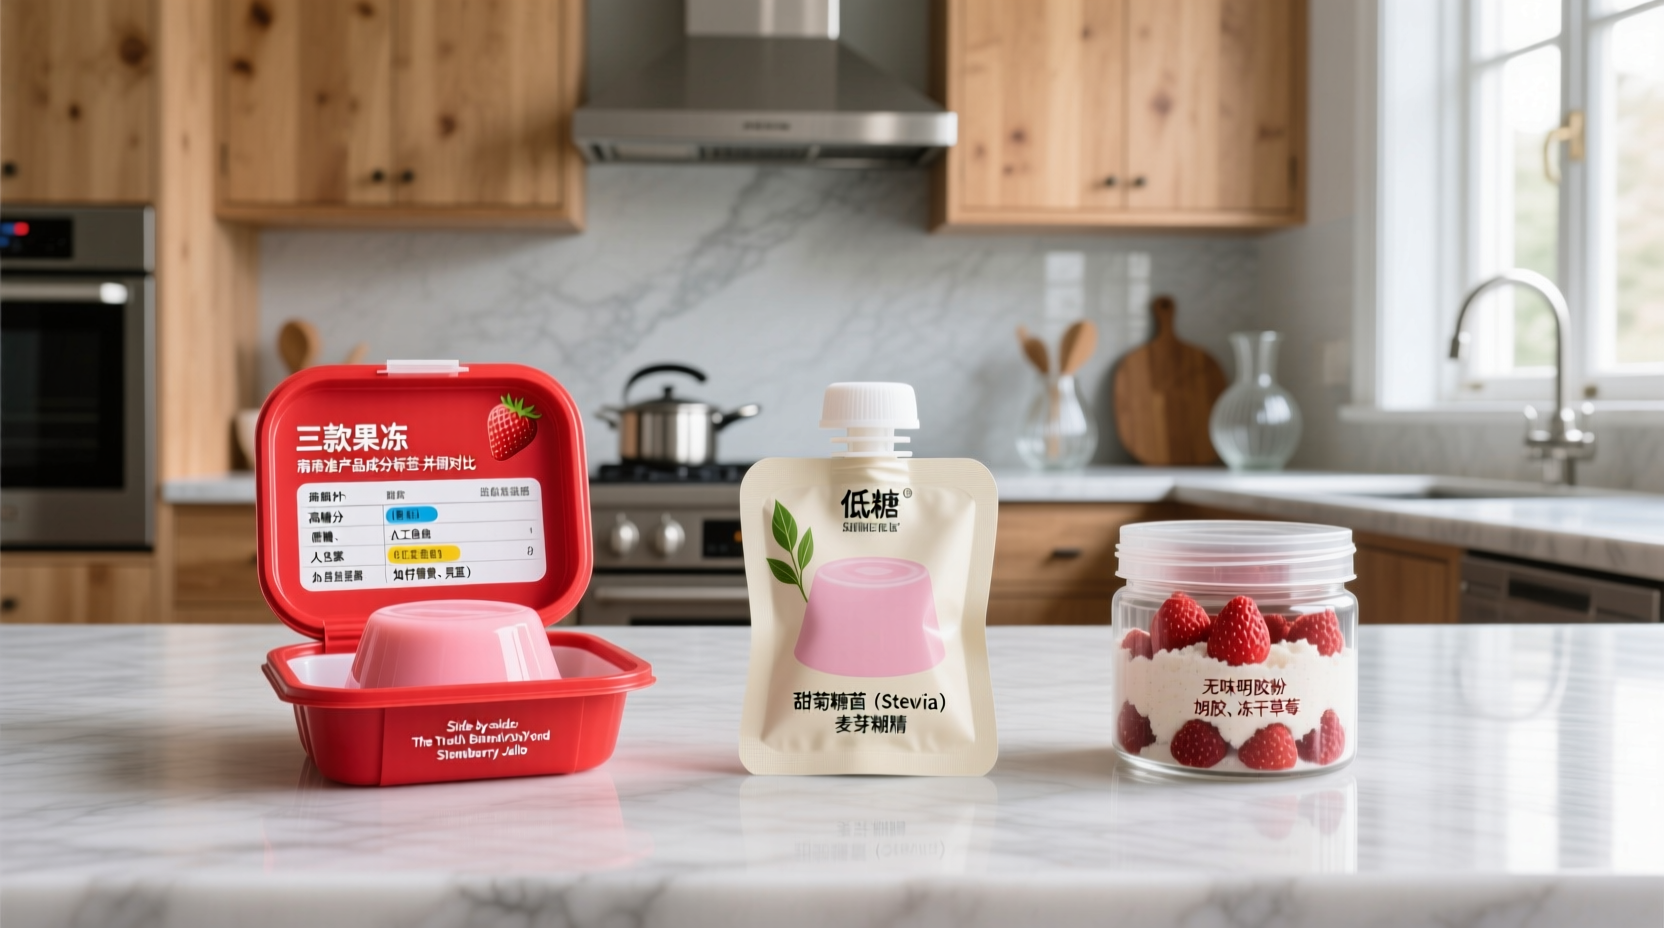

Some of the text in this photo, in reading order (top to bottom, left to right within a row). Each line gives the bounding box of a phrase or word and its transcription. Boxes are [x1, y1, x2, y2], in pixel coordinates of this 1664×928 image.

[296, 421, 409, 453] 三款果冻
[840, 488, 900, 519] 低糖
